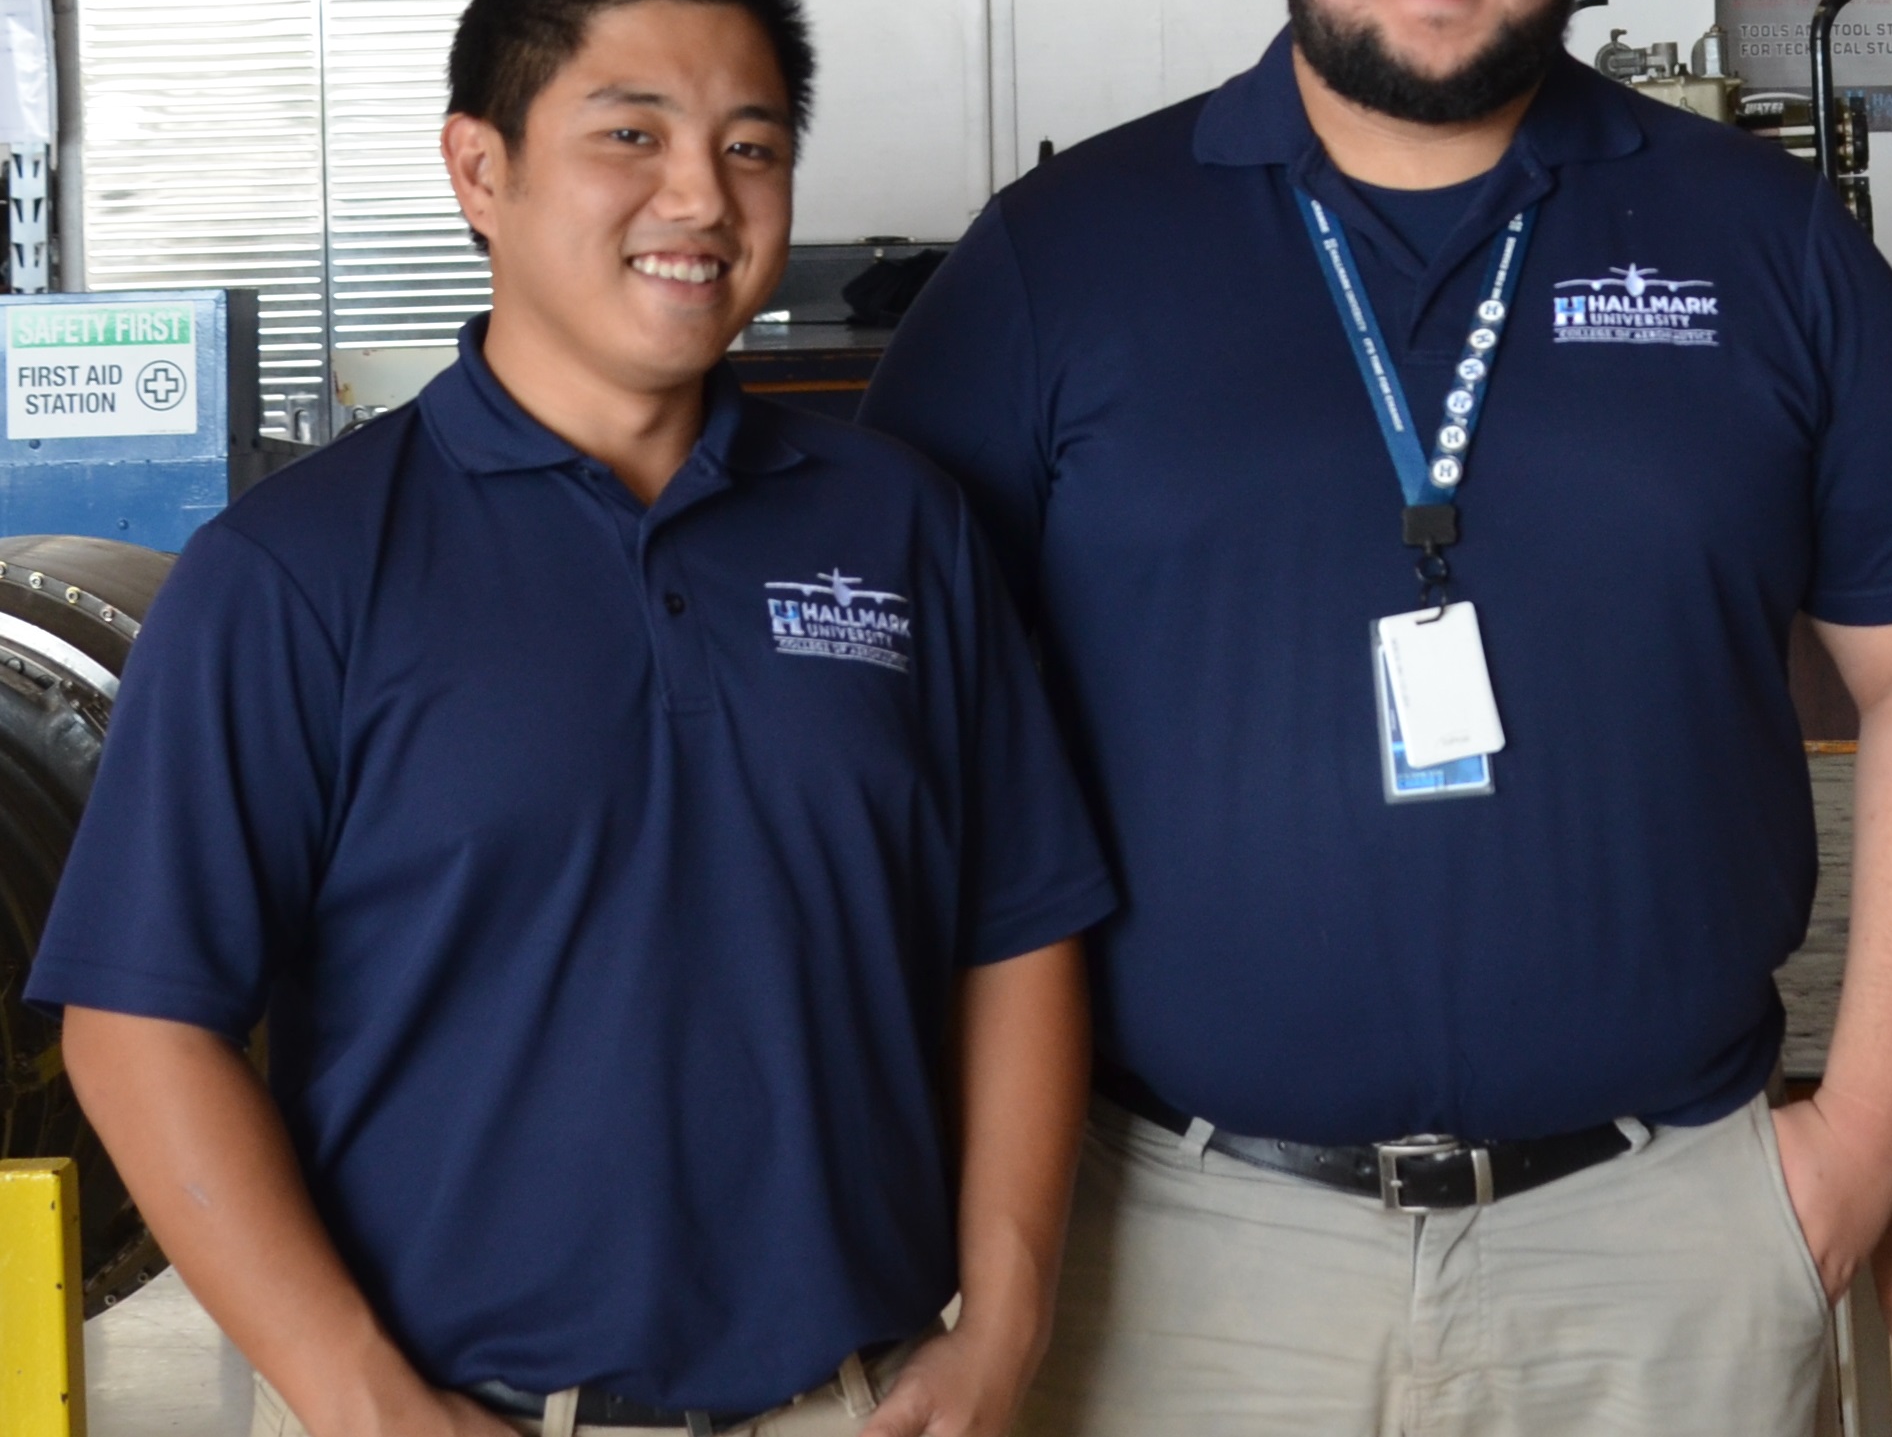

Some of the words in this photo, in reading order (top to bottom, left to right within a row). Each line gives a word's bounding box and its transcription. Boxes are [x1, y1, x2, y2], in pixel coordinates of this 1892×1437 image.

[1740, 24, 1789, 38] TOOLS
[1833, 23, 1871, 37] TOOL
[1741, 43, 1771, 56] FOR
[1776, 42, 1861, 56] TECHCAL
[1588, 295, 1718, 315] HALLMARK
[18, 313, 108, 344] SAFETY
[115, 311, 181, 342] FIRST
[1590, 313, 1690, 328] UNIVERSITY
[18, 366, 80, 387] FIRST
[86, 364, 122, 385] AID
[25, 392, 116, 415] STATION
[802, 602, 912, 639] HALLMARK
[806, 622, 893, 648] UNIVERSITY
